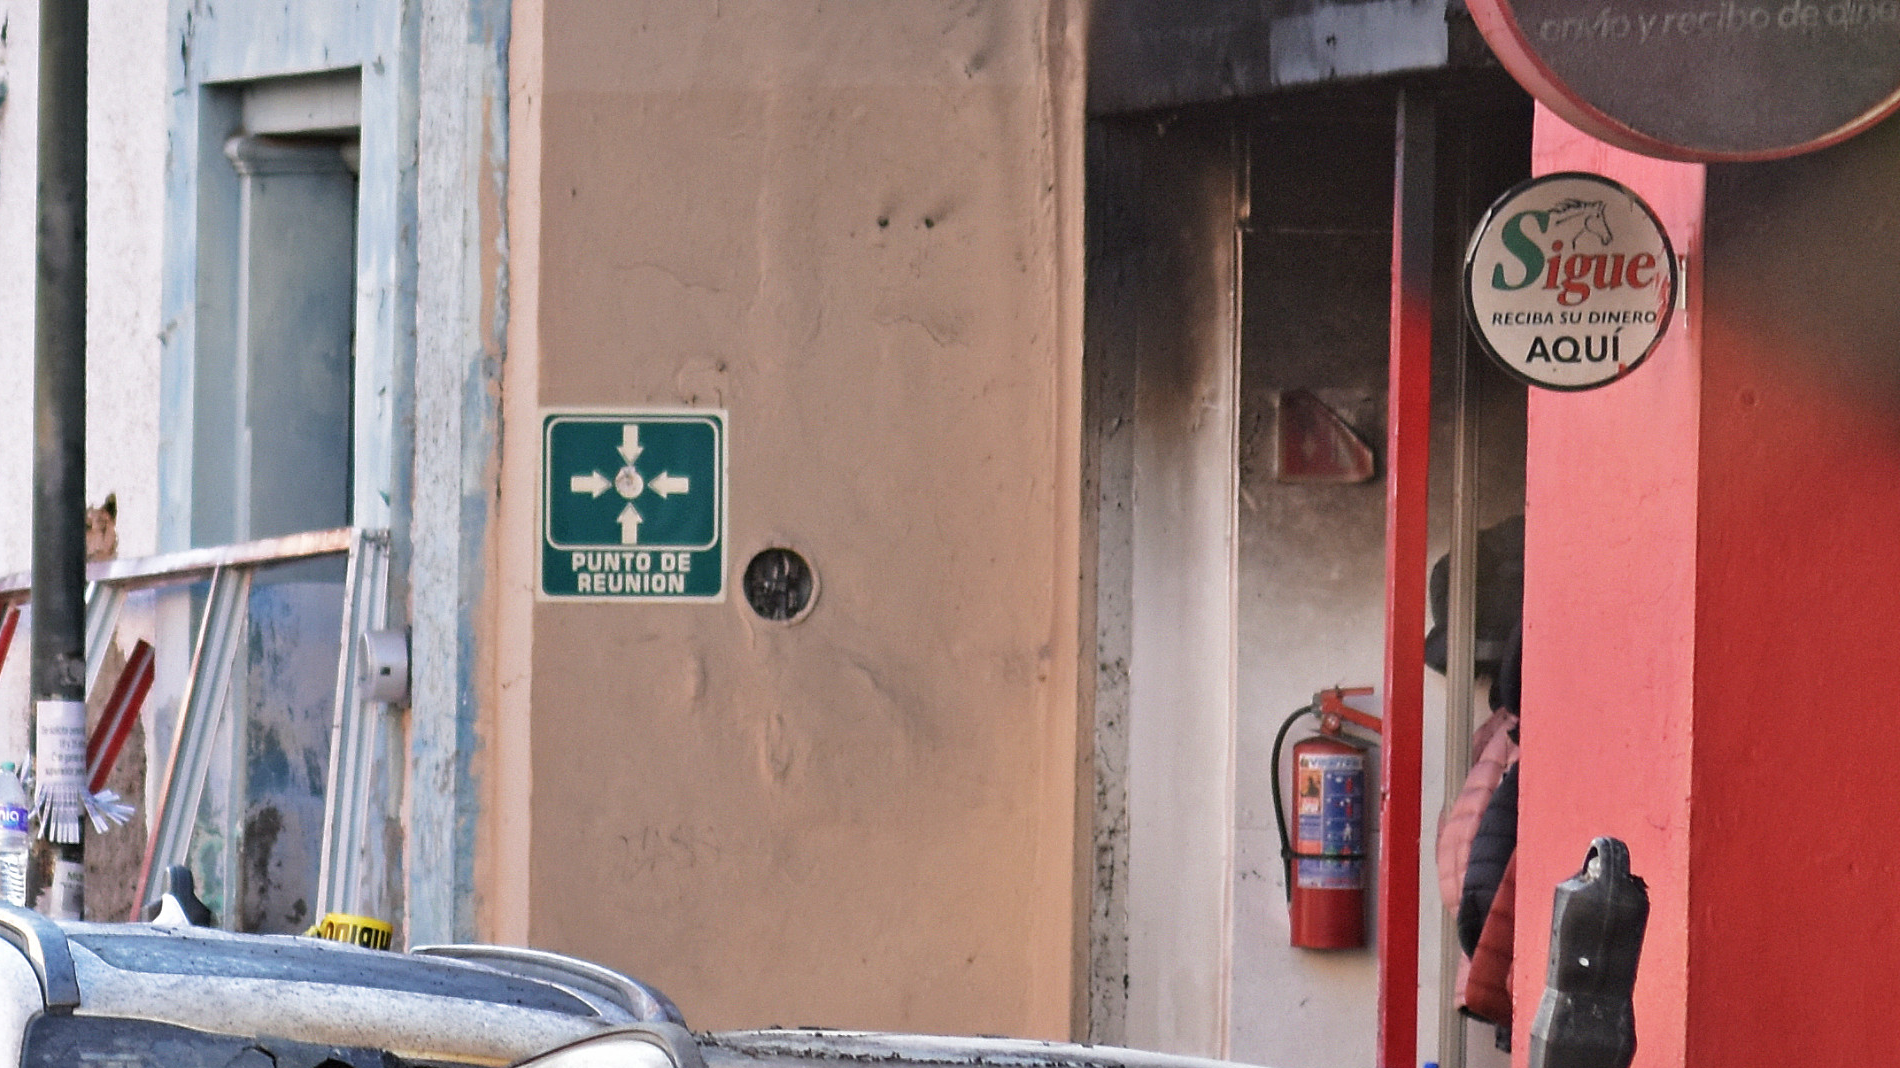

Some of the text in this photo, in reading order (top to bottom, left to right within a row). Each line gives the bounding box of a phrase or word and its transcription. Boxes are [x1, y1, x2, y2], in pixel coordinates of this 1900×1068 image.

[1637, 13, 1657, 43] y
[1662, 1, 1770, 33] recibo
[1777, 0, 1819, 27] de
[1491, 210, 1656, 307] Sigue
[1491, 310, 1658, 327] RECIBA SU DINERO
[1525, 326, 1621, 364] AQUÍ
[571, 552, 691, 573] PUNTO DE
[577, 572, 685, 594] REUNION
